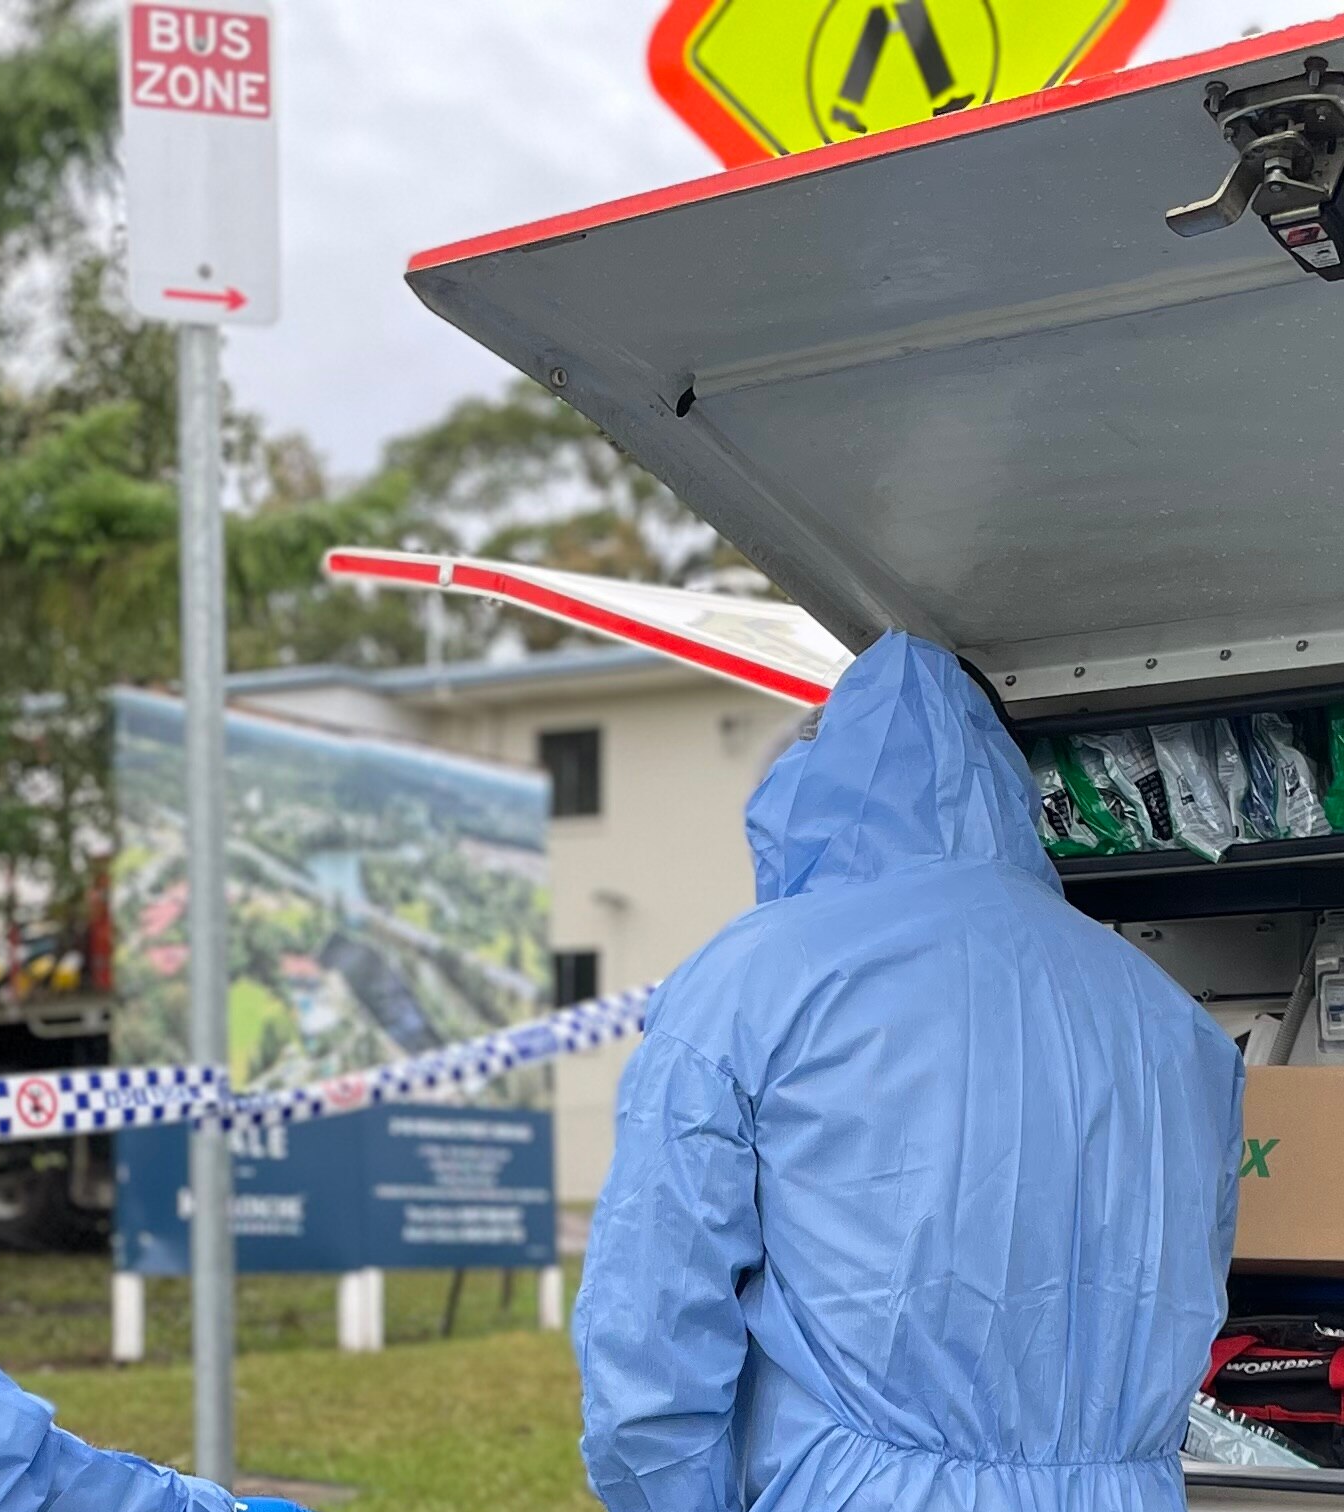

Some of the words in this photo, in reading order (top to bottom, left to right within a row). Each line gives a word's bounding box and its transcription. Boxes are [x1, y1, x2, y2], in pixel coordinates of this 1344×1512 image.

[148, 10, 251, 60] BUS
[135, 61, 267, 113] ZONE
[1239, 1139, 1280, 1178] X
